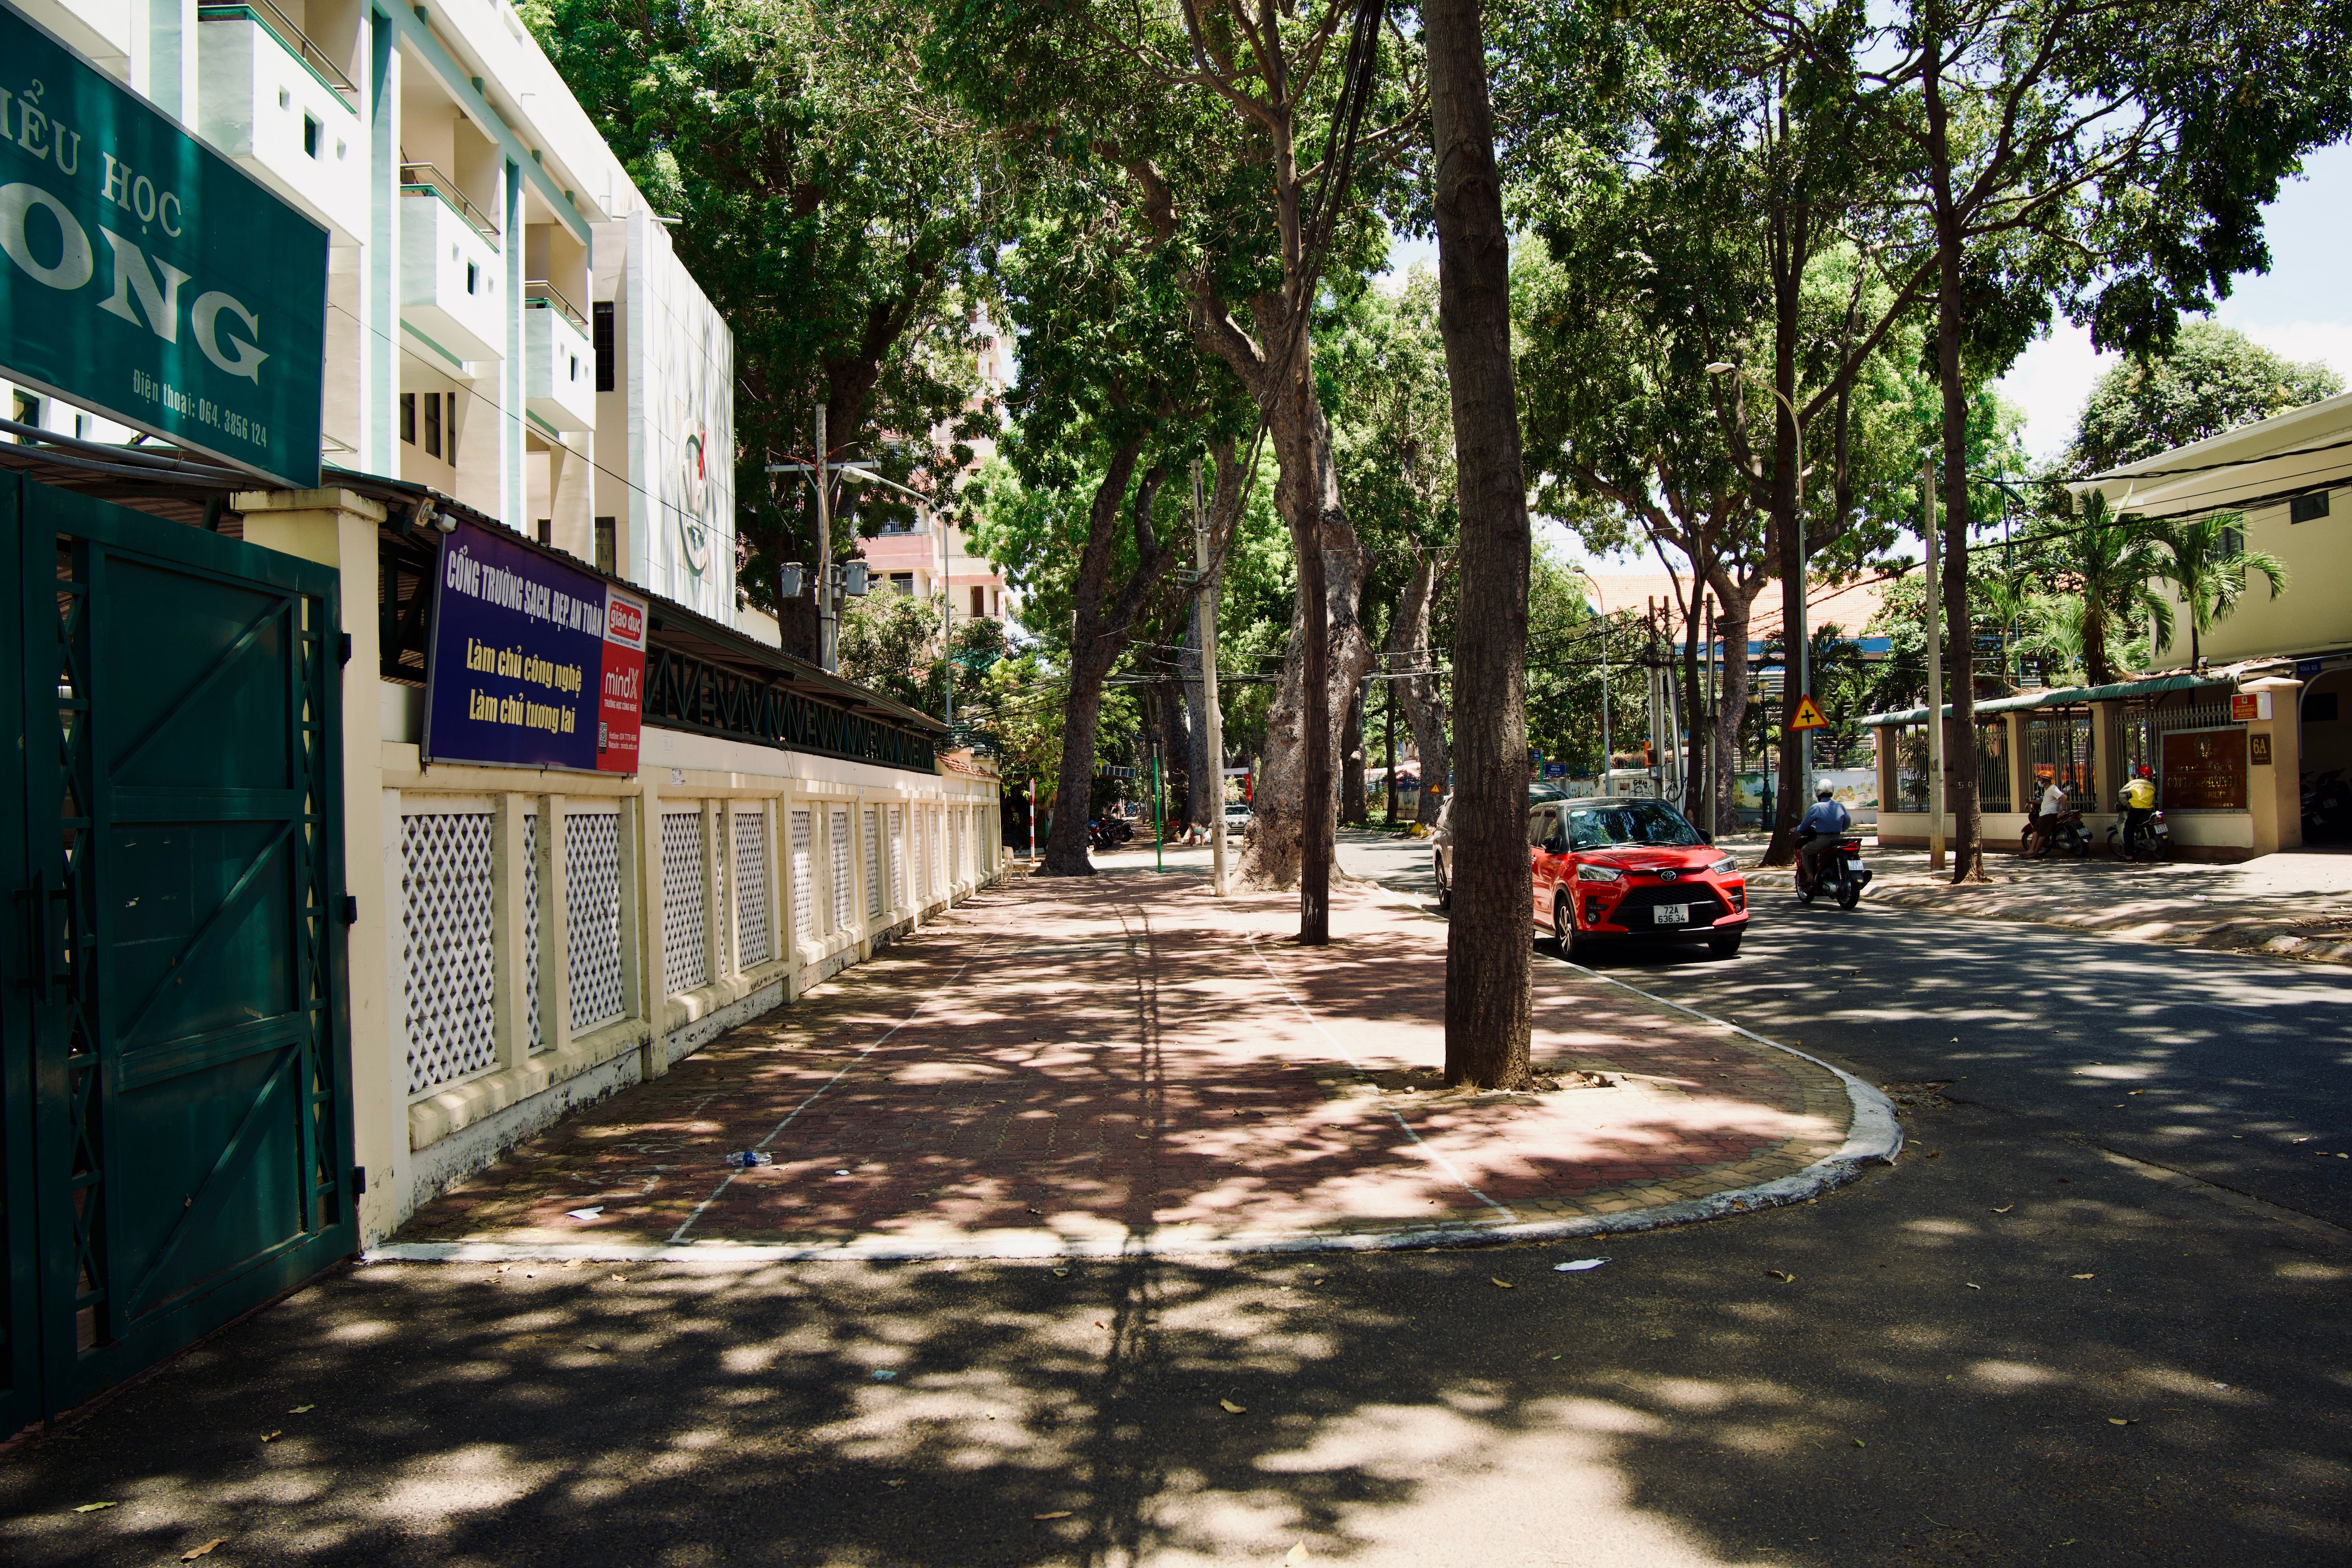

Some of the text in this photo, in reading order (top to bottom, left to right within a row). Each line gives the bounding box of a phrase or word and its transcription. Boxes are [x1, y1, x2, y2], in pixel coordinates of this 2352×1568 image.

[101, 151, 181, 238] HỌC
[0, 182, 270, 387] ONG
[133, 369, 267, 448] Điện thoại: 064. 3856 124
[447, 545, 603, 638] CỔNG TRƯỜNG SẠCH, ĐẸP, AN TOÀN
[610, 604, 627, 629] giáo
[628, 612, 641, 637] dục
[466, 637, 582, 699] Làm chủ công nghệ
[605, 666, 639, 699] mindX
[469, 689, 575, 734] Làm chủ tương lai
[2253, 738, 2267, 754] 6A
[1658, 914, 1685, 923] 636.34
